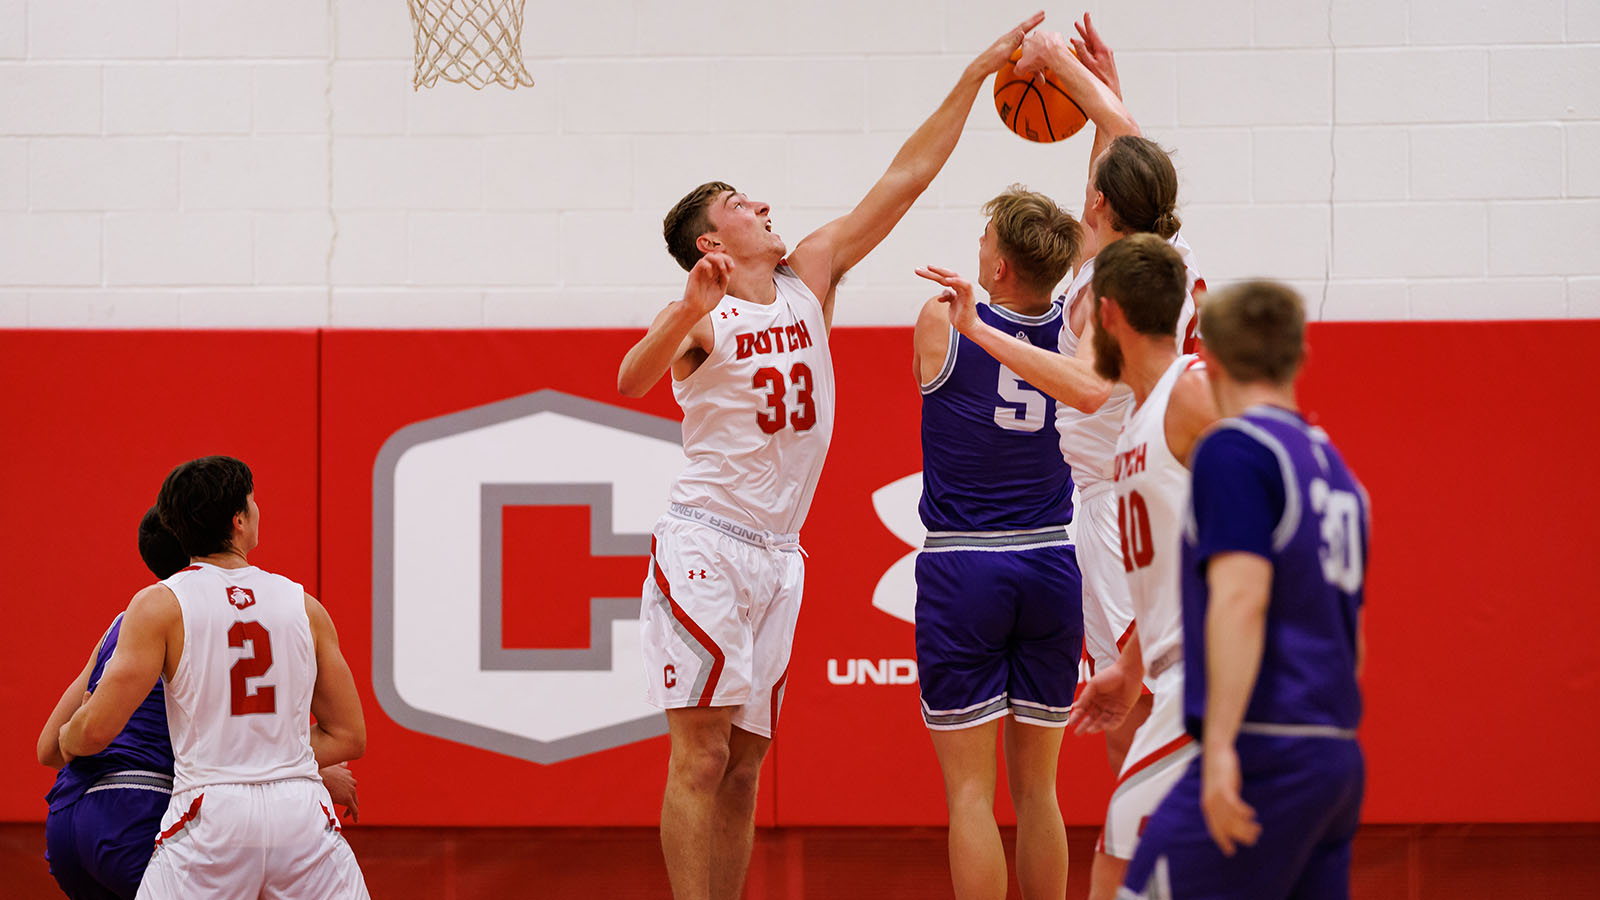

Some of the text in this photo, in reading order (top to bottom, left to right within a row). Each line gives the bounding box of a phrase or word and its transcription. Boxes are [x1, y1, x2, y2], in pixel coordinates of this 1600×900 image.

[736, 319, 813, 361] DUTCH
[751, 362, 817, 435] 33
[994, 363, 1047, 433] 5
[1113, 442, 1147, 482] UTCH
[671, 502, 763, 544] UNDER ARMO
[1117, 489, 1155, 573] 10
[1309, 477, 1363, 595] 30
[227, 619, 277, 717] 2
[663, 664, 676, 689] C
[827, 658, 918, 685] UND
